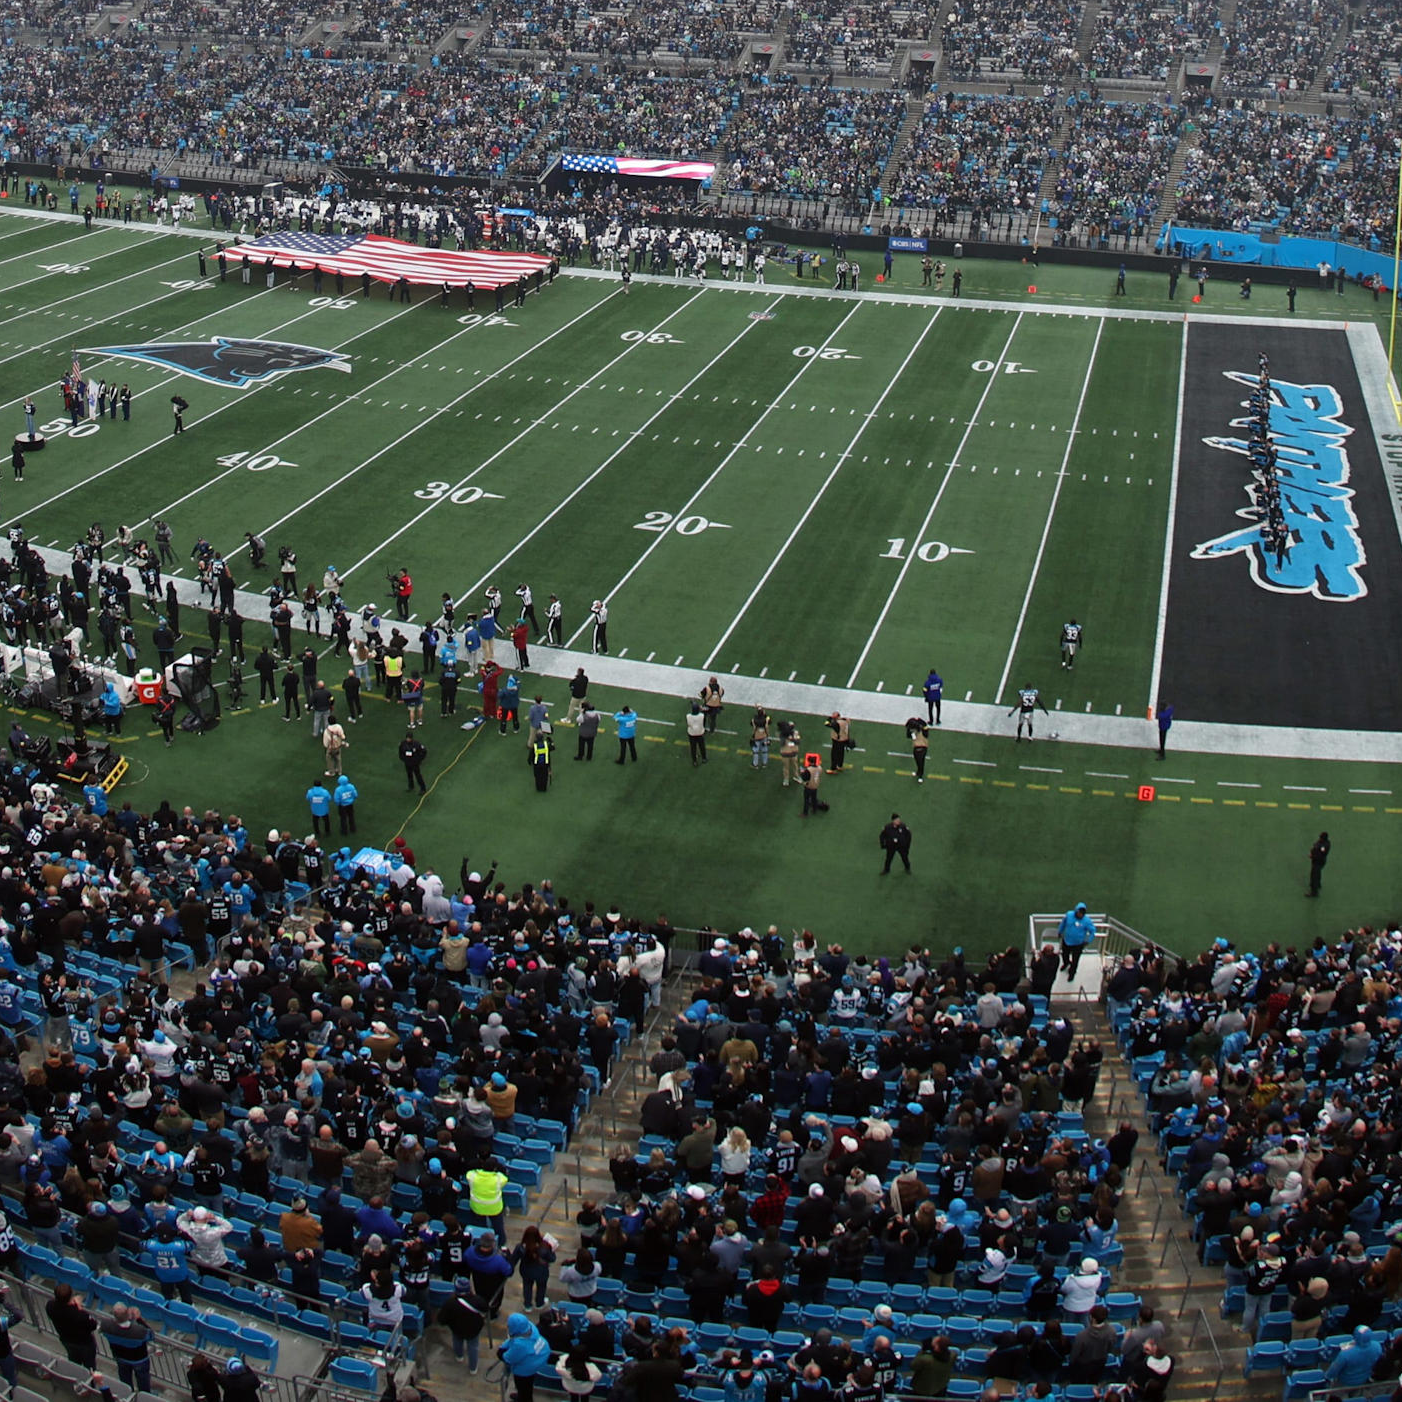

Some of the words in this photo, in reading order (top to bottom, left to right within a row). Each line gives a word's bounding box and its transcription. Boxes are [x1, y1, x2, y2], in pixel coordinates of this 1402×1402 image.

[39, 417, 100, 438] 50
[216, 450, 280, 471] 40
[413, 481, 484, 504] 30
[633, 510, 710, 536] 20
[879, 537, 954, 564] 10
[1066, 629, 1078, 639] 33
[211, 908, 228, 920] 55
[71, 1028, 90, 1046] 79
[213, 1068, 231, 1082] 59
[777, 1156, 795, 1174] 91
[953, 1176, 964, 1193] 9
[157, 1257, 178, 1270] 21
[449, 1247, 462, 1263] 9
